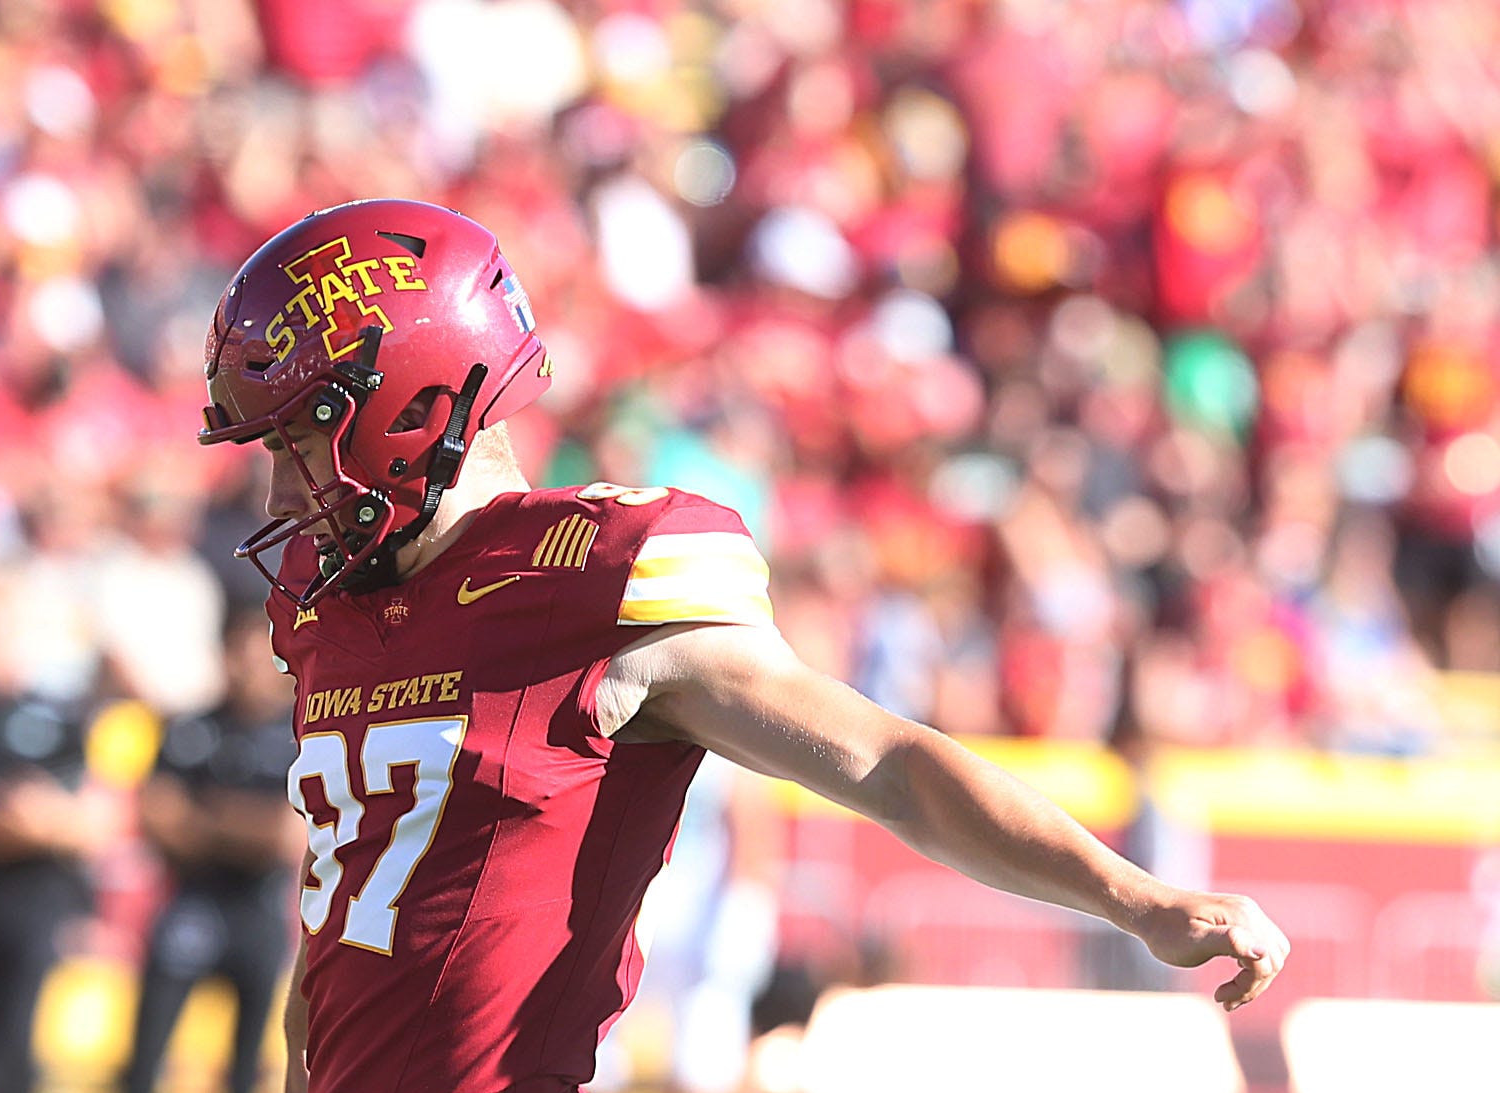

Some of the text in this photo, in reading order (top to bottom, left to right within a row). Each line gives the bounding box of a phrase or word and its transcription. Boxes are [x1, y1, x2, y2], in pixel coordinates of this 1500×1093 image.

[265, 256, 428, 363] STATE
[383, 604, 409, 620] STATE
[303, 670, 464, 725] IOWA STATE
